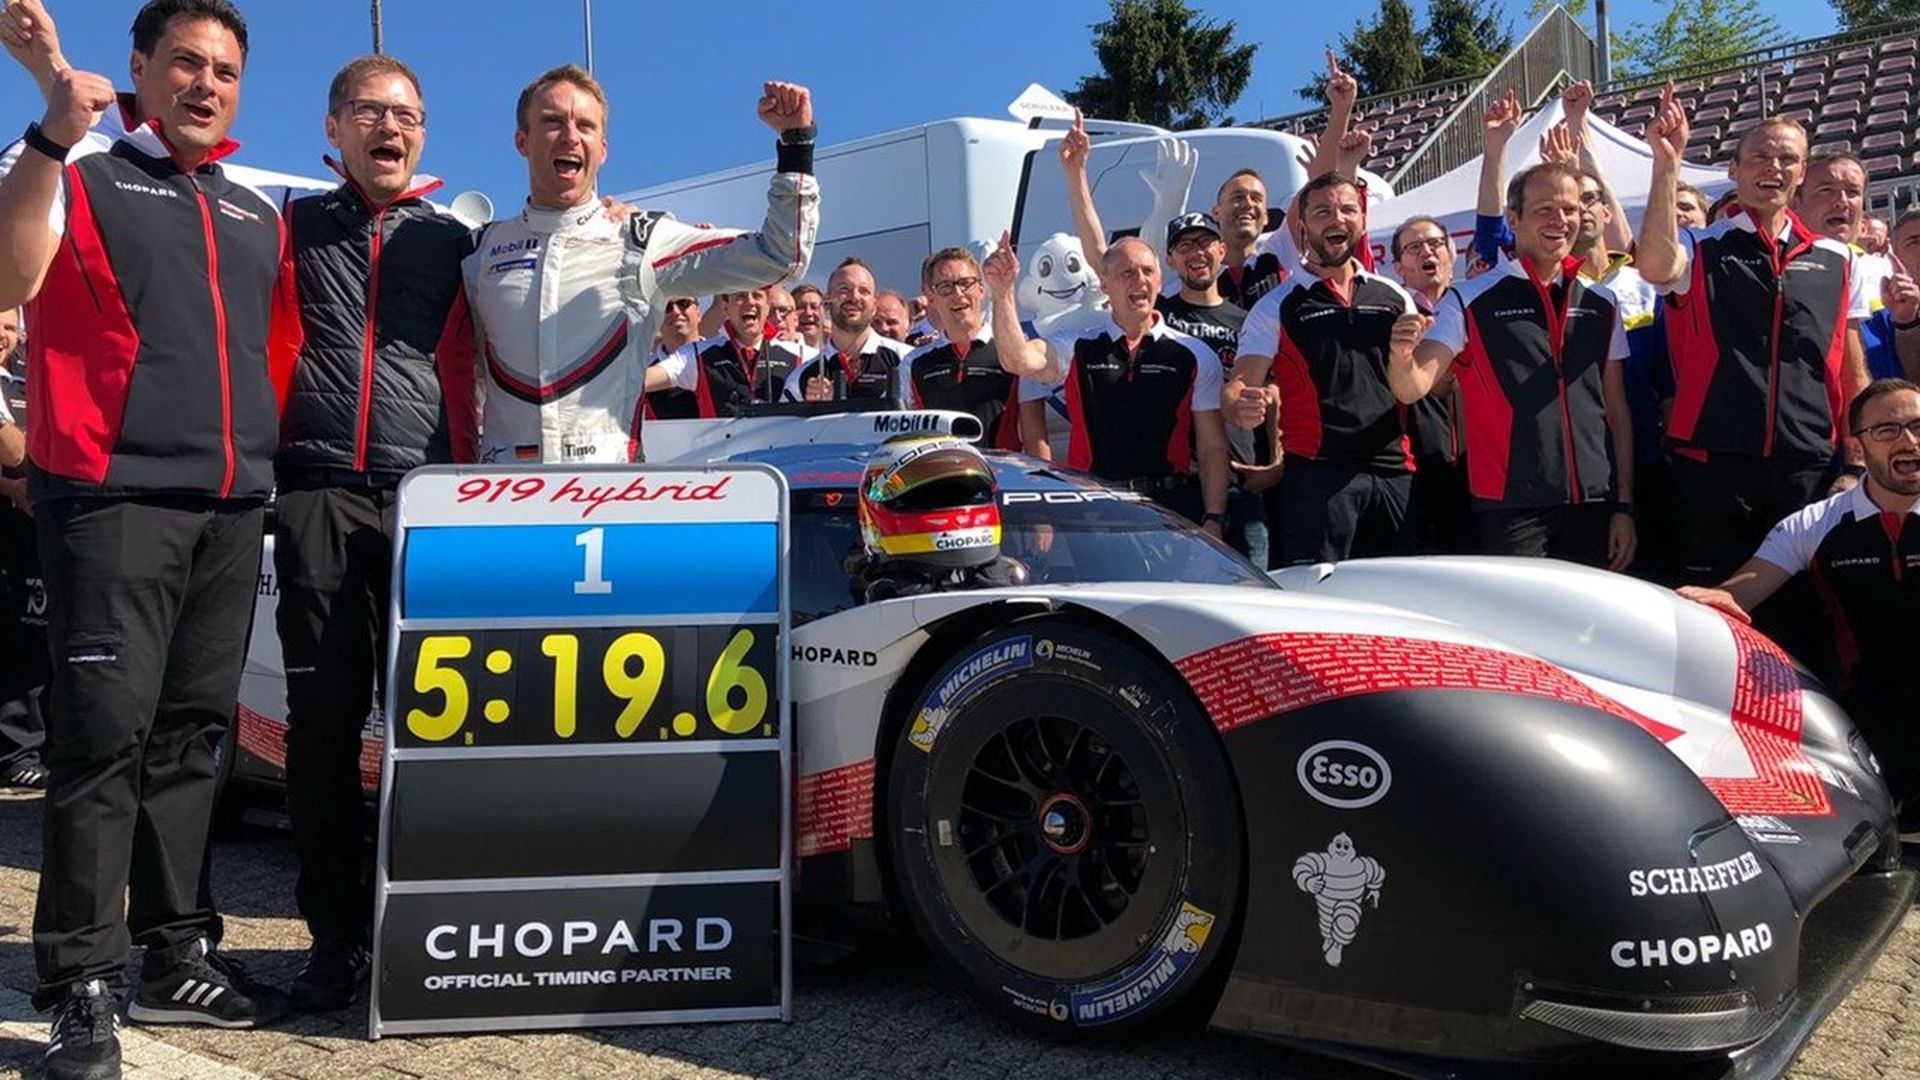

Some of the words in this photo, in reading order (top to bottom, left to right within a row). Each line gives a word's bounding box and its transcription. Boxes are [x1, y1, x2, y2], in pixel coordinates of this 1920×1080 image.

[490, 241, 523, 257] Mobil
[874, 415, 922, 432] Mobil
[564, 444, 597, 457] Timo
[457, 478, 545, 503] 919
[550, 476, 731, 518] hybrid
[573, 527, 613, 595] 1
[791, 646, 878, 667] HOPARD
[939, 642, 1027, 703] MICHELIN
[1312, 755, 1377, 789] Esso
[1628, 851, 1762, 896] SCHAEFFLER
[425, 917, 733, 960] CHOPARD
[1610, 922, 1773, 968] CHOPARD
[424, 972, 532, 990] OFFICIAL
[534, 970, 617, 986] TIMING
[621, 967, 732, 982] PARTNER
[1079, 957, 1176, 1020] MICHELIN
